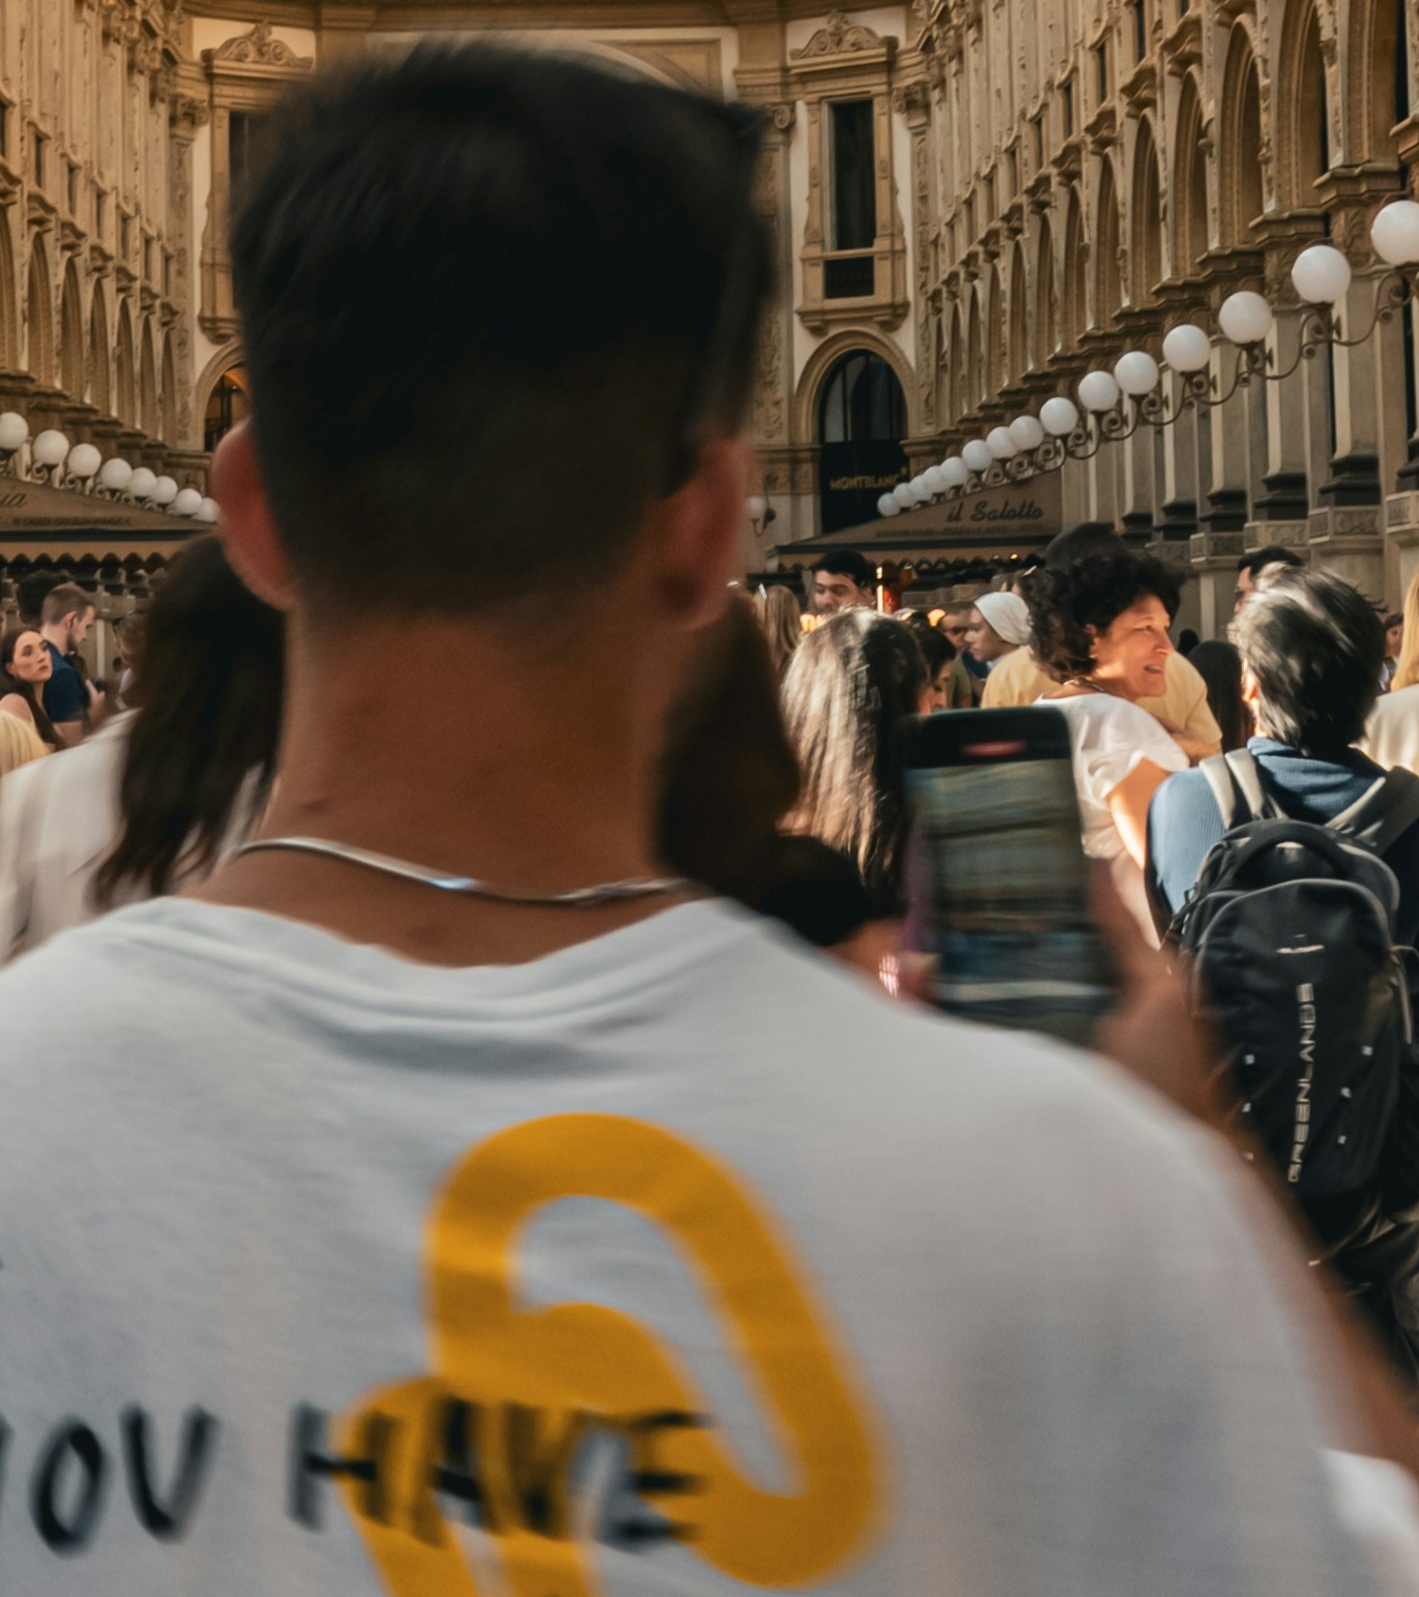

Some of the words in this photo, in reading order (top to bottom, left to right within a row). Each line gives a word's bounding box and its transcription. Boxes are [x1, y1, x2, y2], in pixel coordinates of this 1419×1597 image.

[947, 501, 964, 522] il
[971, 500, 1043, 521] Salotto
[284, 1400, 712, 1552] HAVE
